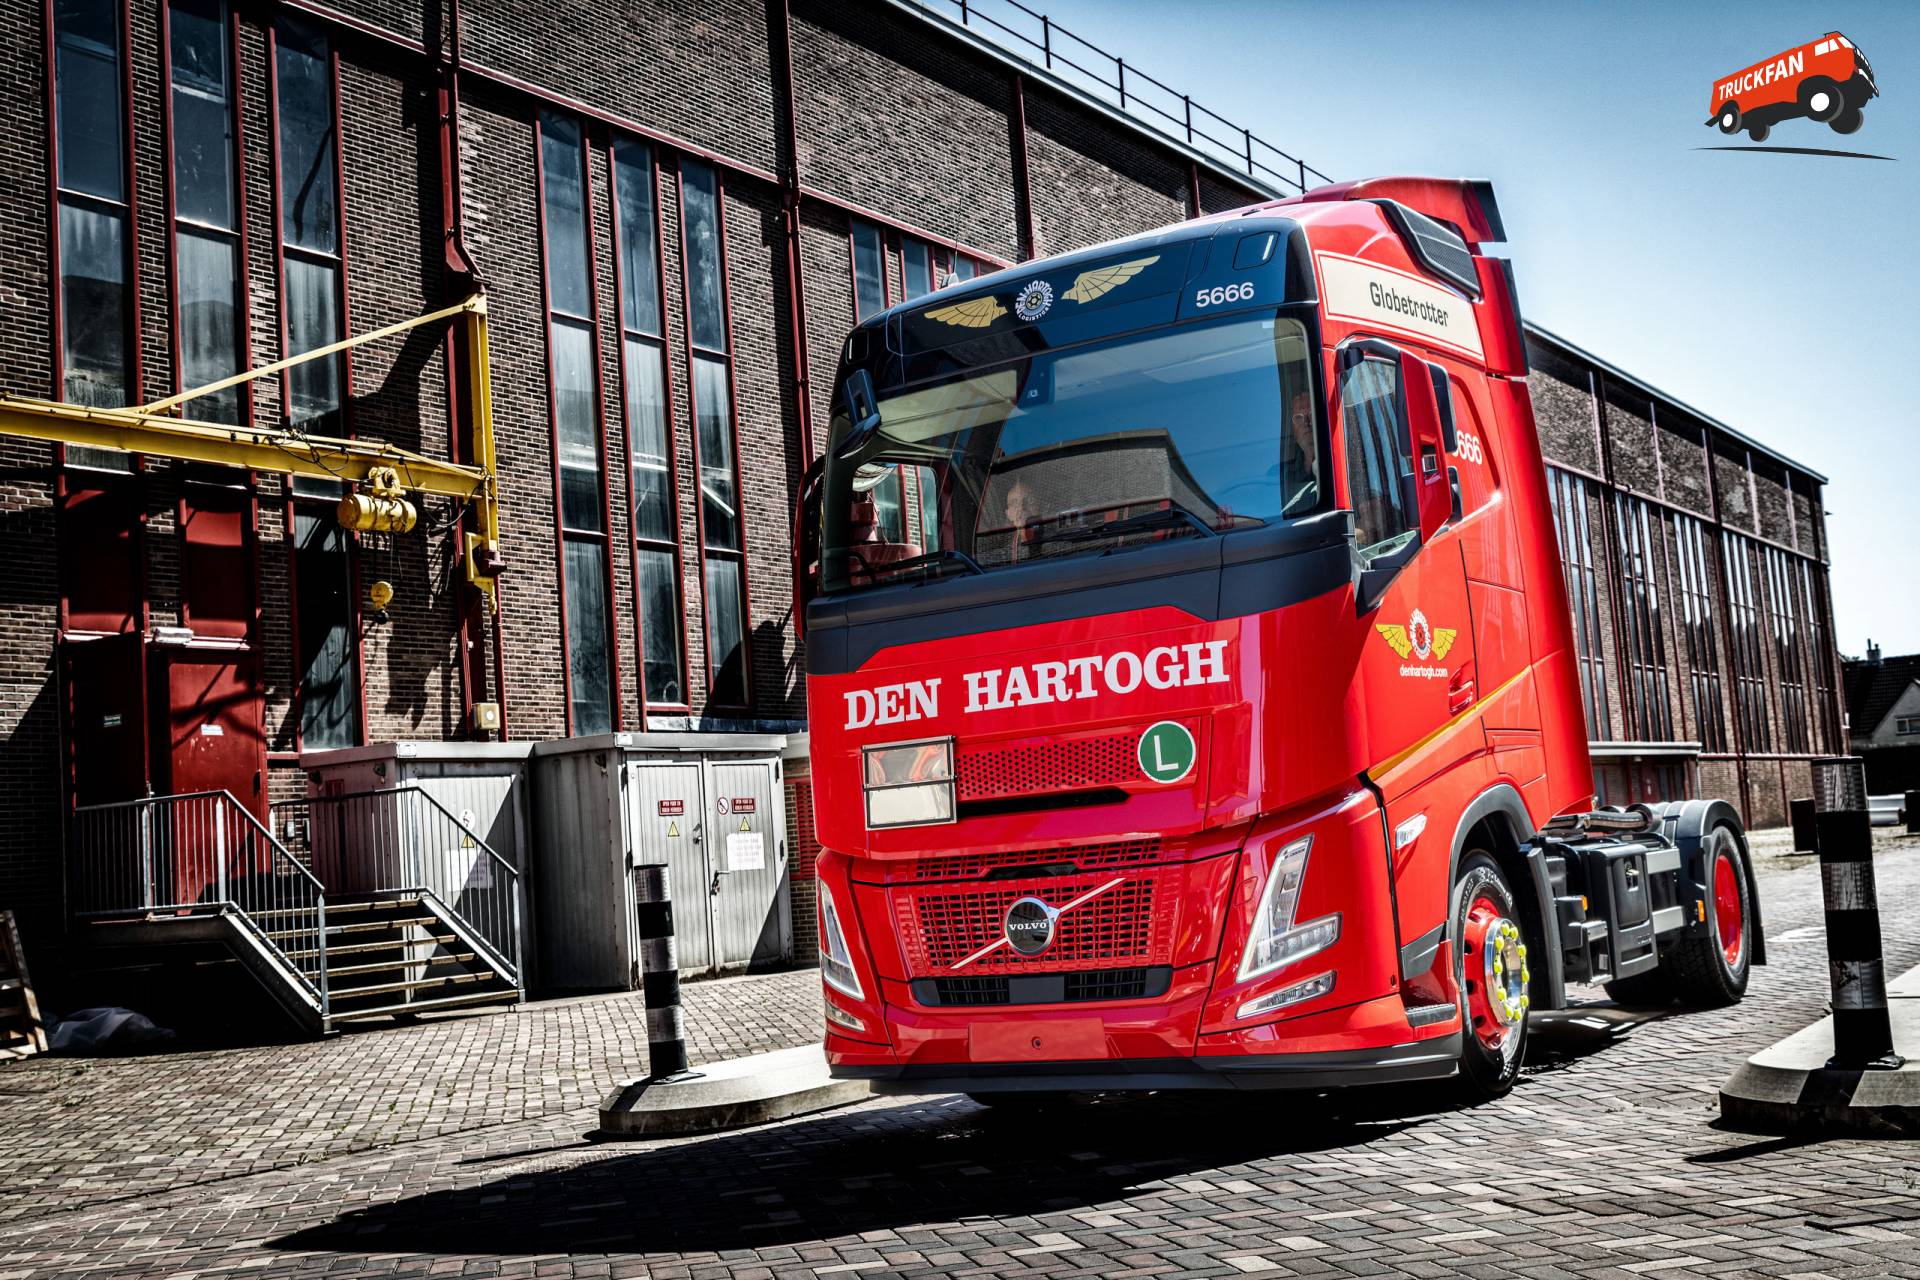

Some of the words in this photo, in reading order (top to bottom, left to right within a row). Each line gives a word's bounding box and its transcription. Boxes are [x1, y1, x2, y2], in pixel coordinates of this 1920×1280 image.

[1023, 280, 1054, 307] HARTOGH
[1196, 281, 1255, 308] 5666
[1369, 281, 1449, 327] Globetrotter
[1452, 430, 1482, 465] 666
[843, 677, 942, 731] DEN
[962, 639, 1231, 714] HARTOGH
[1399, 663, 1449, 680] denhartogh.com
[1153, 734, 1179, 771] L
[1008, 922, 1047, 931] VOLVO
